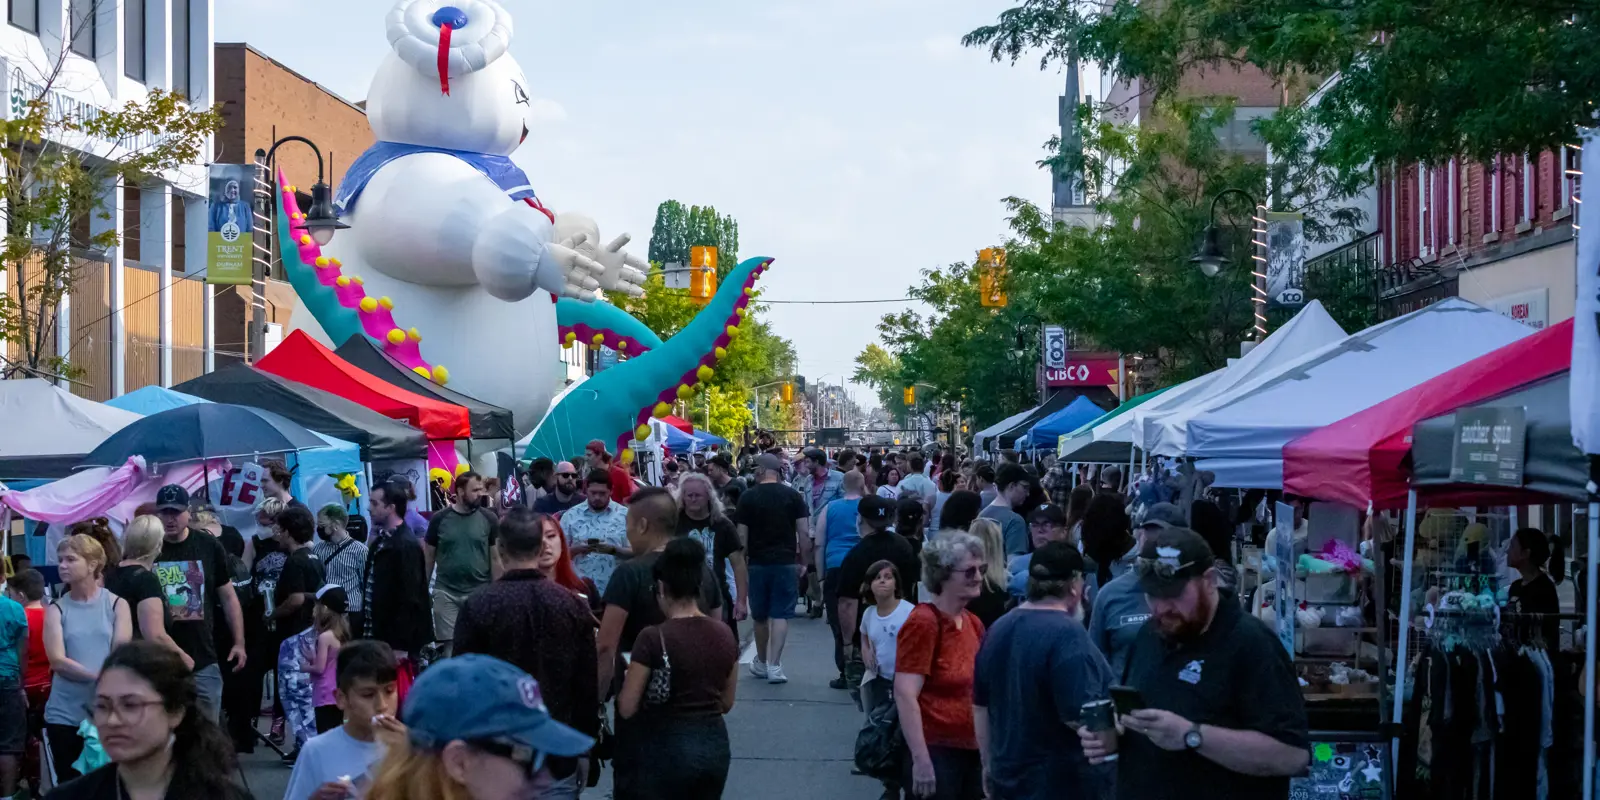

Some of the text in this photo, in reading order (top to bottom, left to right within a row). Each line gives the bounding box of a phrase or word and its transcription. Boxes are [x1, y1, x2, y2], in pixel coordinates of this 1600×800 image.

[216, 245, 244, 253] TRENT
[1282, 293, 1301, 302] 100
[1049, 334, 1064, 361] 100
[1046, 366, 1076, 380] CIBC
[1461, 419, 1511, 451] another spin
[157, 565, 184, 578] EVIL
[160, 574, 187, 586] DEAD
[1128, 614, 1151, 622] anot
